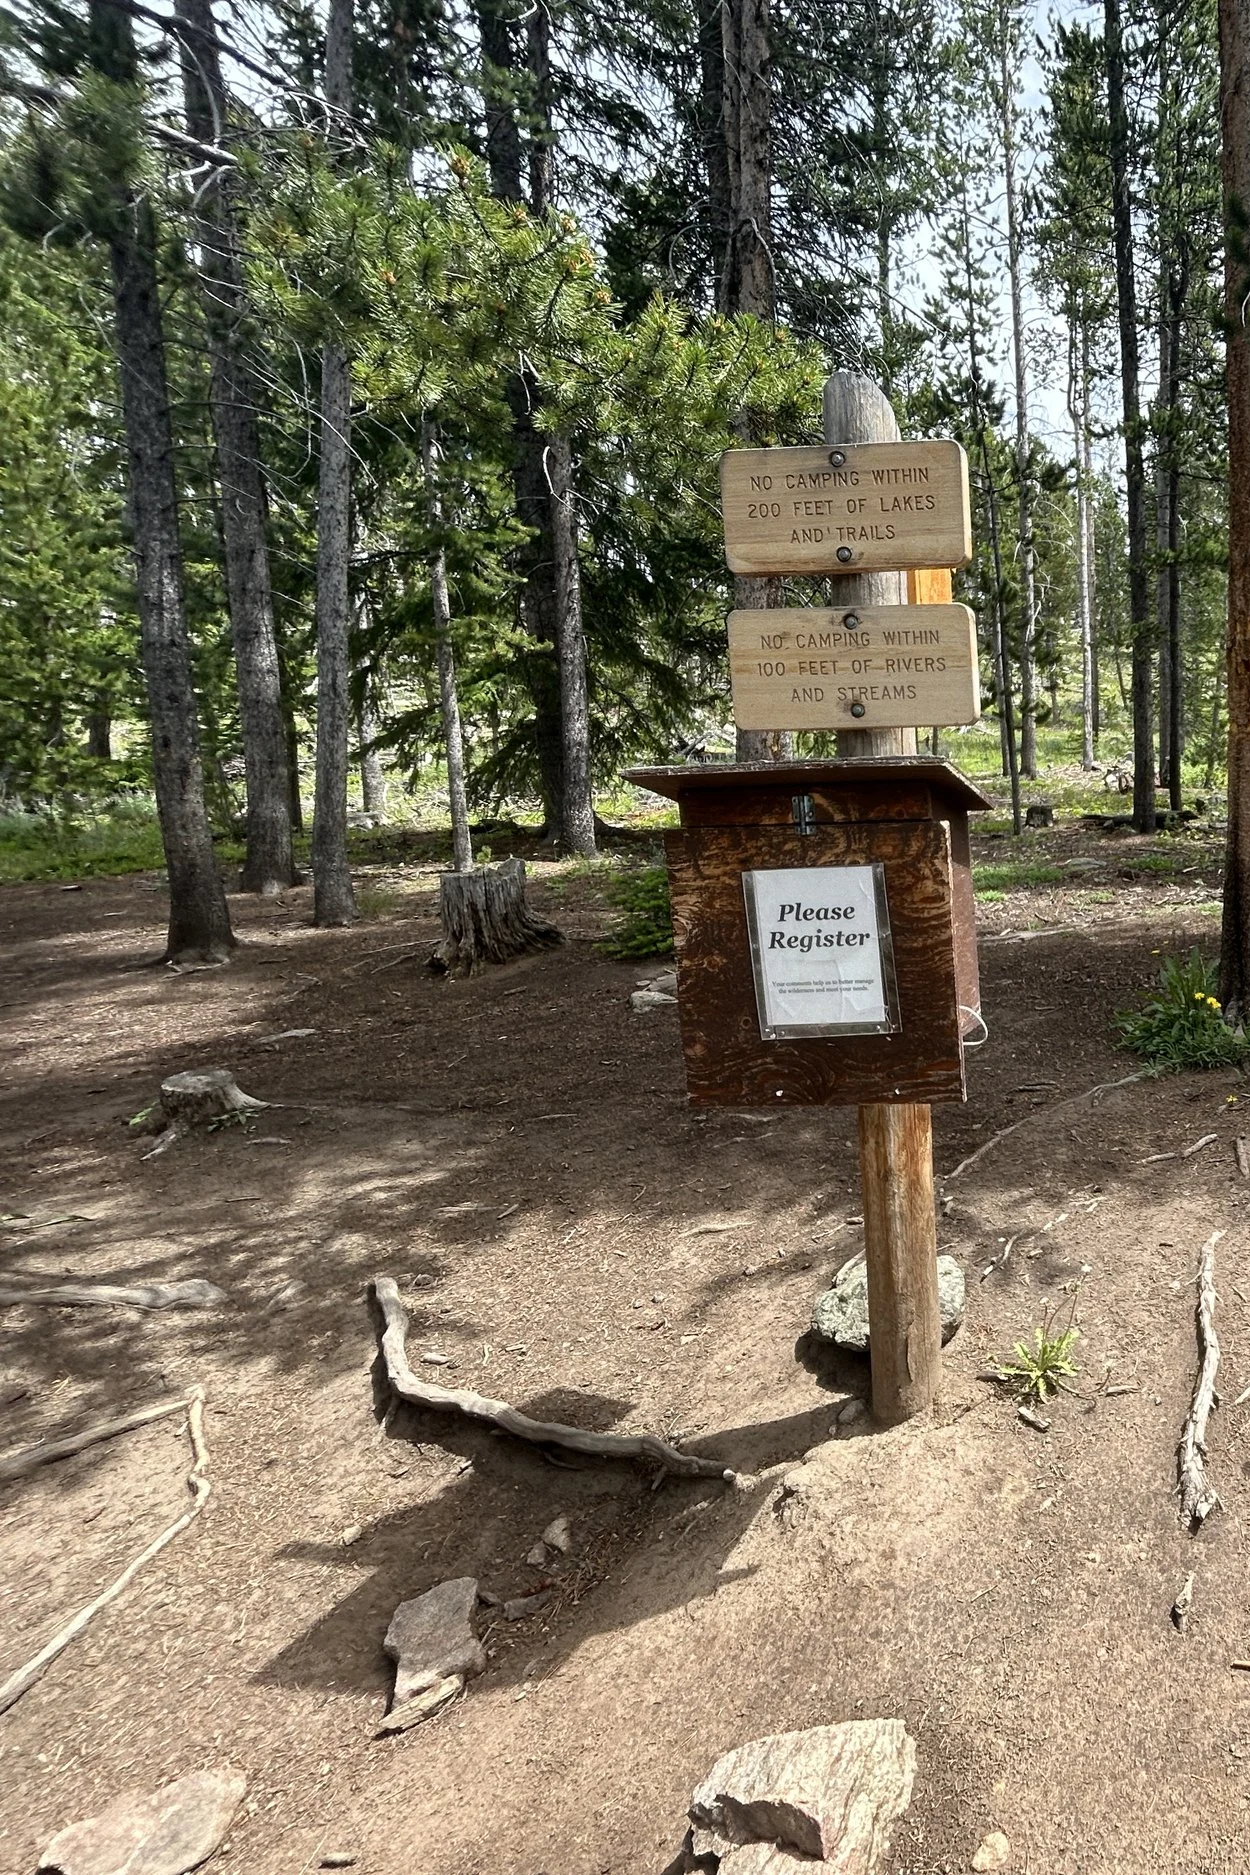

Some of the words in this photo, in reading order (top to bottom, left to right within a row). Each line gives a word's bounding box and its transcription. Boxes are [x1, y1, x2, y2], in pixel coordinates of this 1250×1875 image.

[750, 475, 773, 492] NO
[785, 470, 860, 490] CAMPING
[871, 467, 929, 486] WITHIN
[748, 503, 781, 519] 200
[793, 500, 833, 517] FEET
[847, 498, 866, 513] OF
[880, 495, 936, 512] LAKES
[790, 528, 824, 544] AND
[836, 524, 896, 542] TRAILS
[760, 635, 783, 650] NO
[796, 632, 871, 649] CAMPING
[882, 630, 940, 646] WITHIN
[757, 662, 786, 677] 100
[798, 660, 838, 676] FEET
[852, 659, 872, 674] OF
[885, 657, 946, 673] RIVERS
[791, 687, 824, 702] AND
[837, 685, 917, 701] STREAMS
[777, 902, 855, 923] Please
[768, 928, 870, 953] Register
